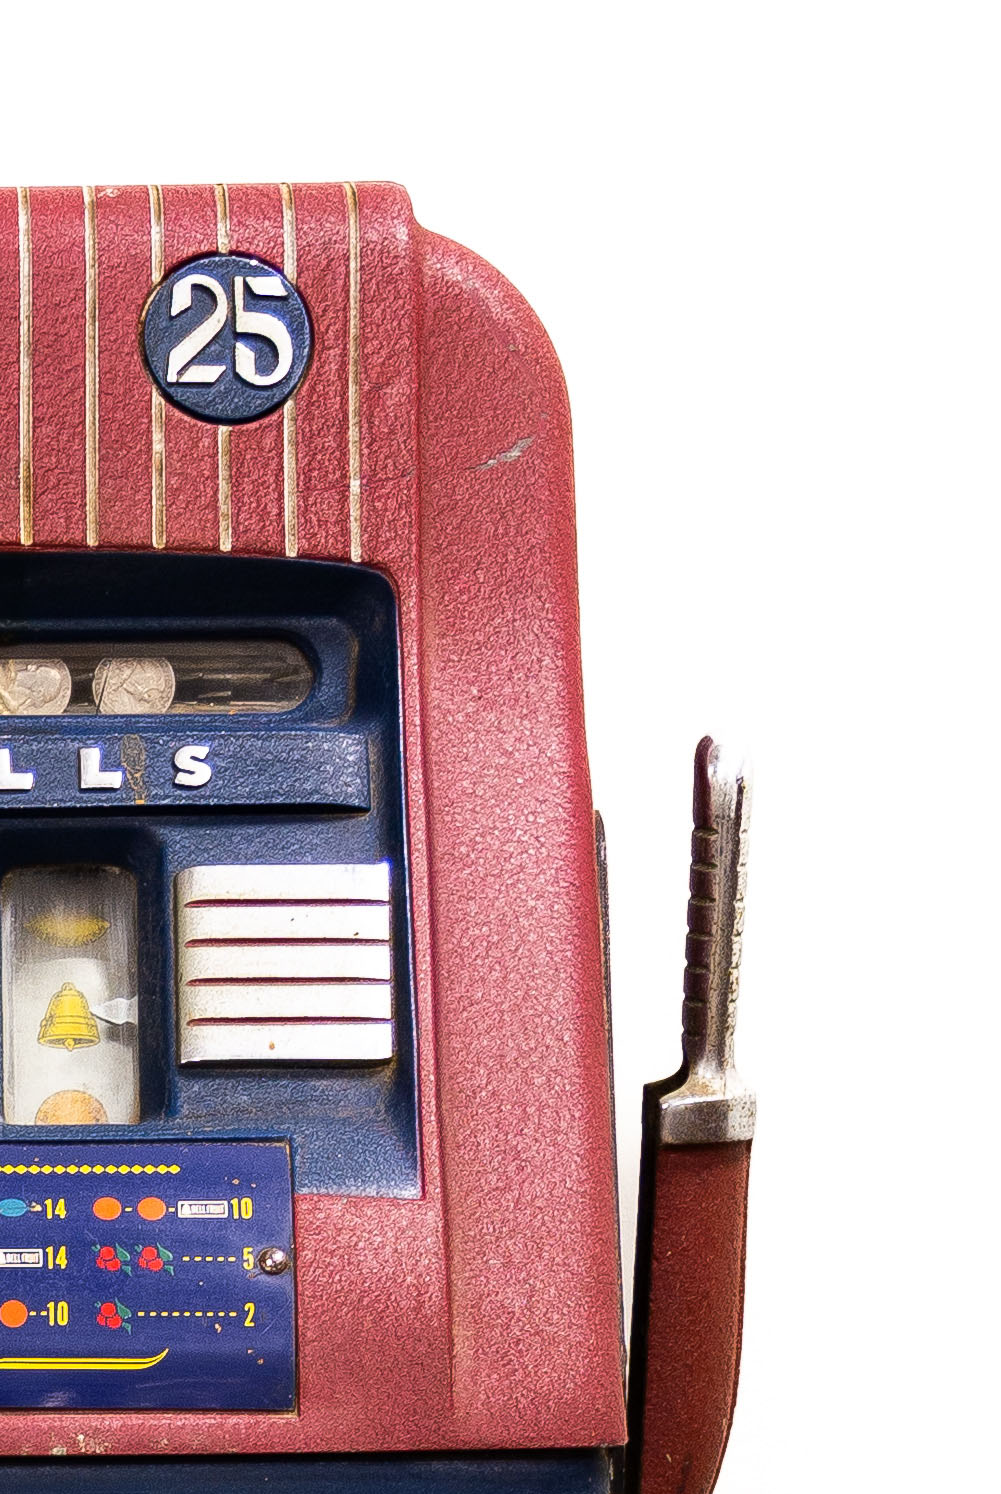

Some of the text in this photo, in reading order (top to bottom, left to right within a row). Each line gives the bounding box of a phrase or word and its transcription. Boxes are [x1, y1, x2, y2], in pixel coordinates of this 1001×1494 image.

[167, 274, 293, 386] 25
[44, 1198, 67, 1220] 14
[230, 1197, 253, 1220] 10
[46, 1246, 68, 1270] 14
[242, 1247, 255, 1270] 5
[47, 1301, 69, 1326] 10
[243, 1302, 255, 1327] 2
